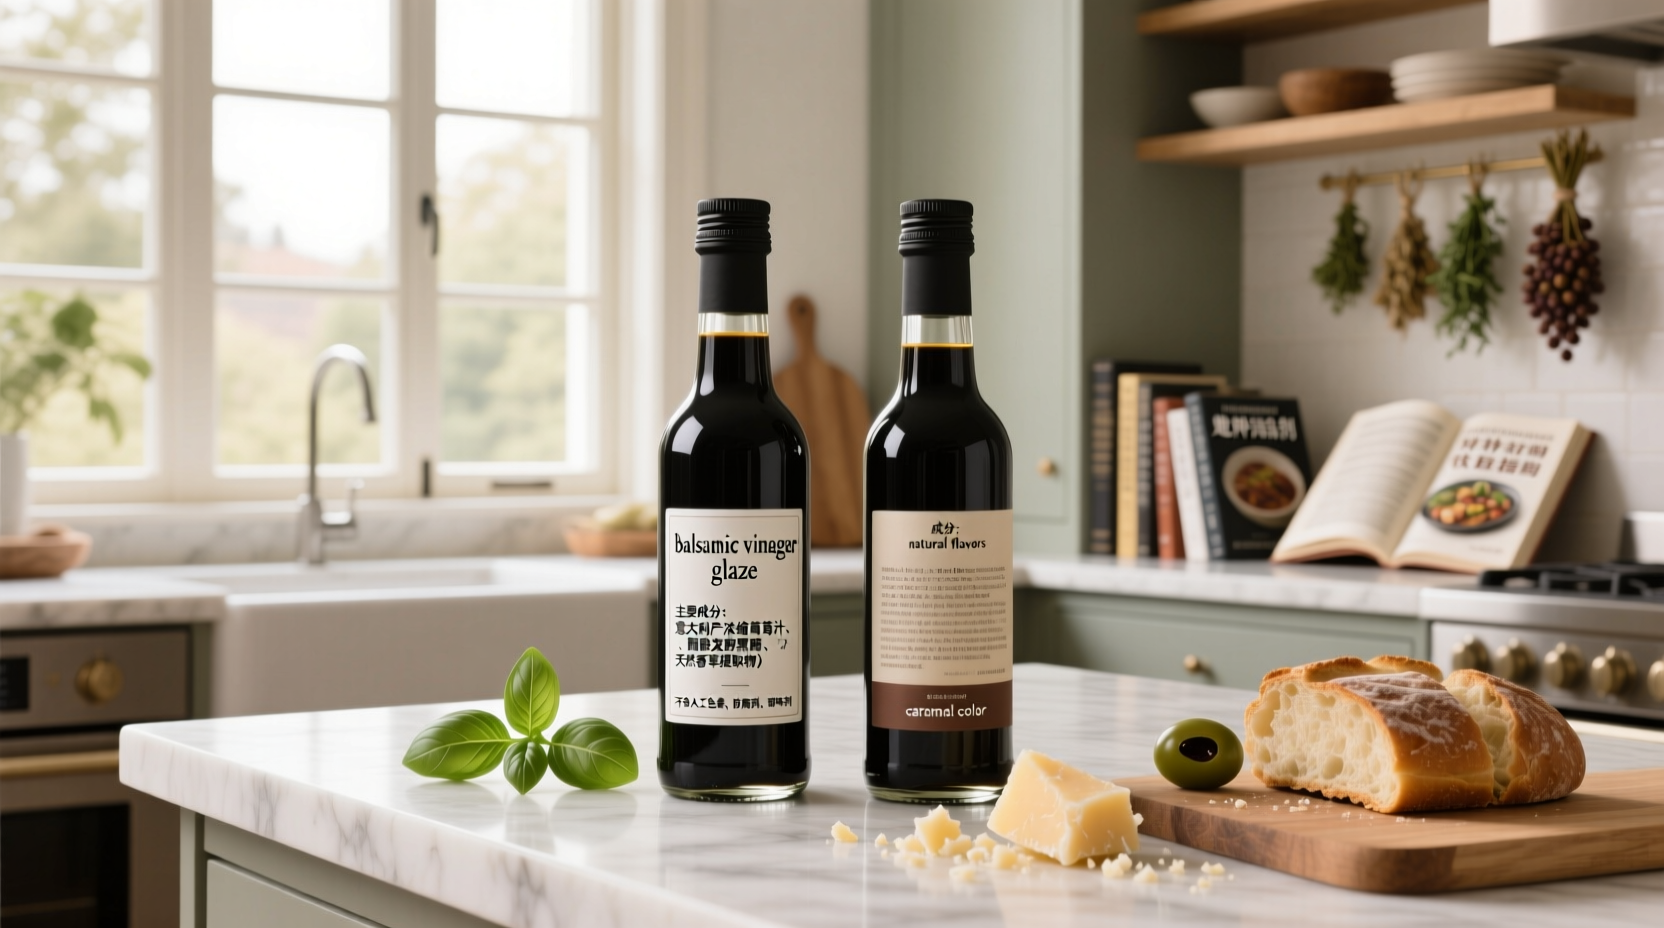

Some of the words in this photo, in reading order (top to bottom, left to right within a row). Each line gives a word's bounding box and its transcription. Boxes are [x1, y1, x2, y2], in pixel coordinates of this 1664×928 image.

[908, 536, 948, 550] natural
[710, 558, 758, 587] glaze
[957, 703, 988, 718] color
